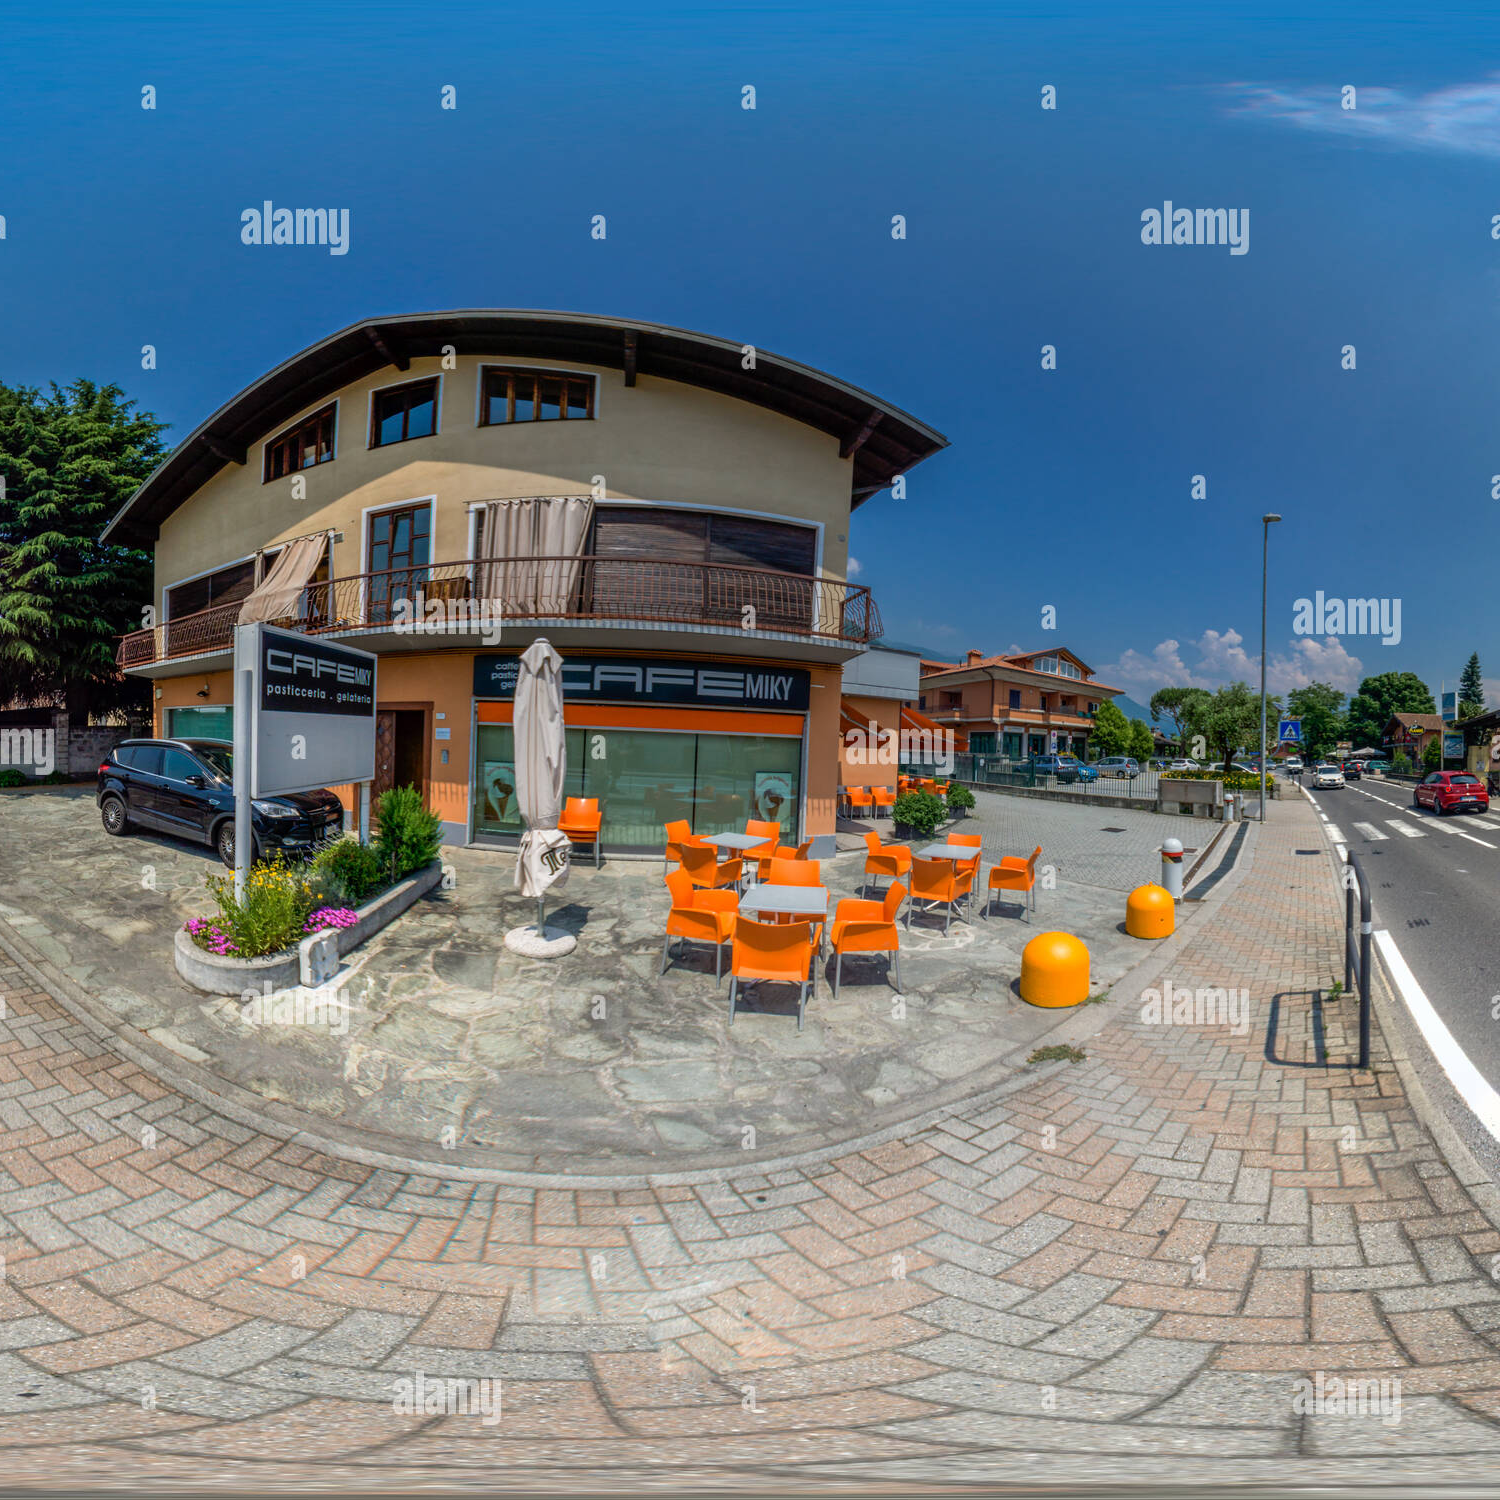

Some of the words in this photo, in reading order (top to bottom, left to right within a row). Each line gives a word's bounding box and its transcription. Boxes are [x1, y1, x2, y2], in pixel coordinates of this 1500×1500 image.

[491, 672, 518, 680] pastic
[500, 681, 516, 690] gel
[746, 673, 794, 701] MIKY
[267, 684, 326, 699] pasticceria
[337, 692, 371, 704] gelateria
